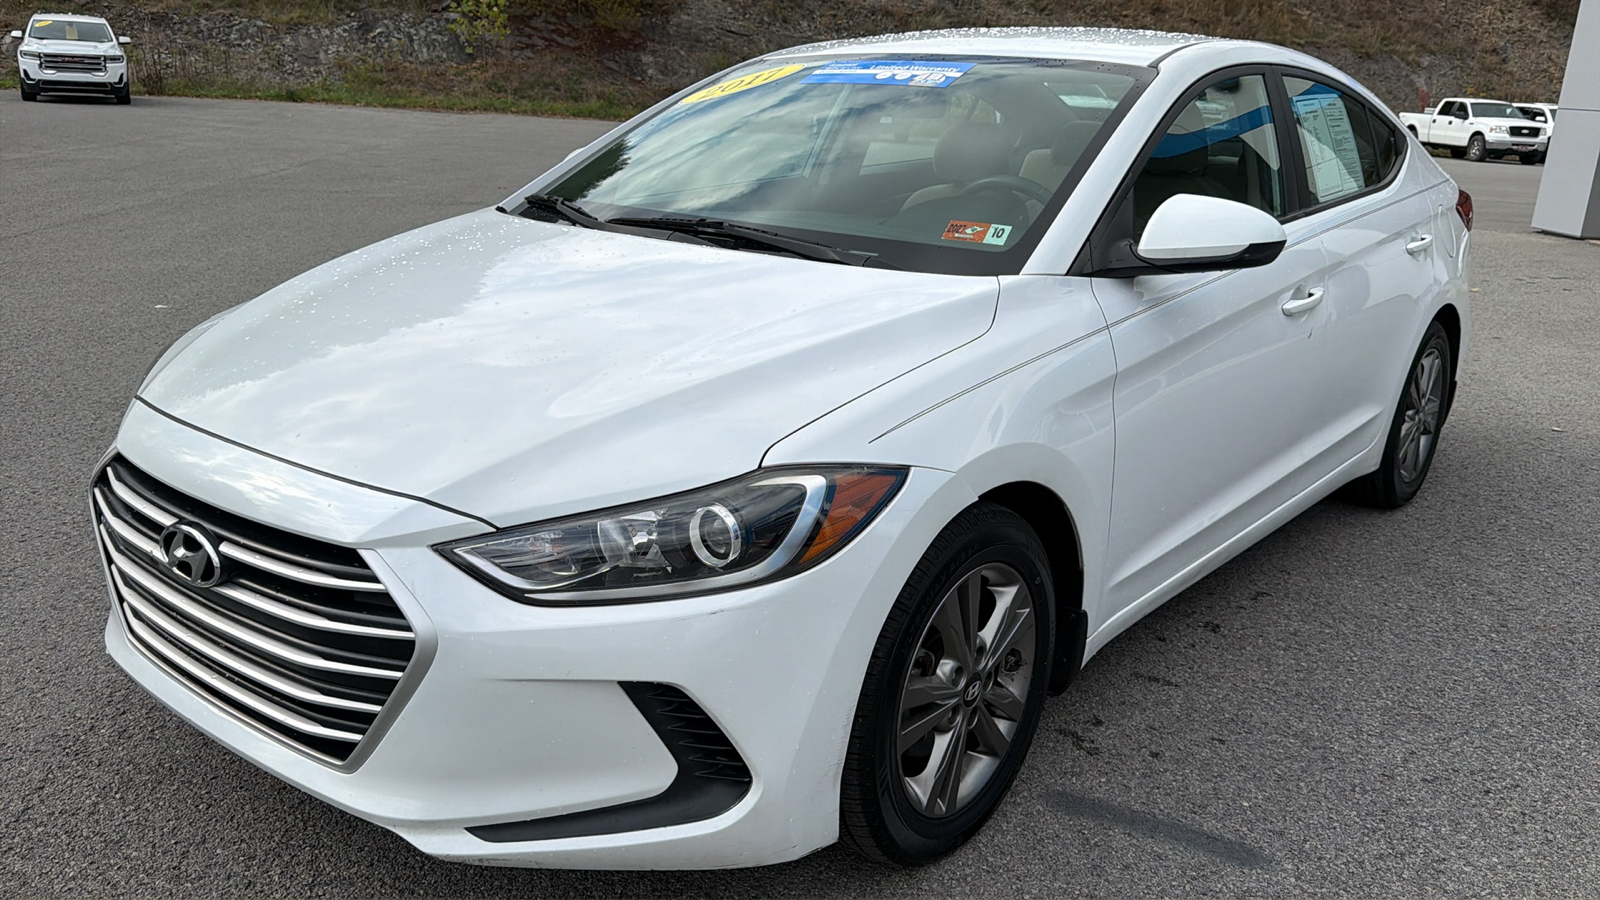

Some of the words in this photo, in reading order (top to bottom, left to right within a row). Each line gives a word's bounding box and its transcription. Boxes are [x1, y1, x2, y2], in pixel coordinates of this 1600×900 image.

[910, 65, 961, 73] Warranty
[697, 67, 788, 101] 2017
[946, 223, 967, 234] 2027
[991, 227, 1005, 239] 10
